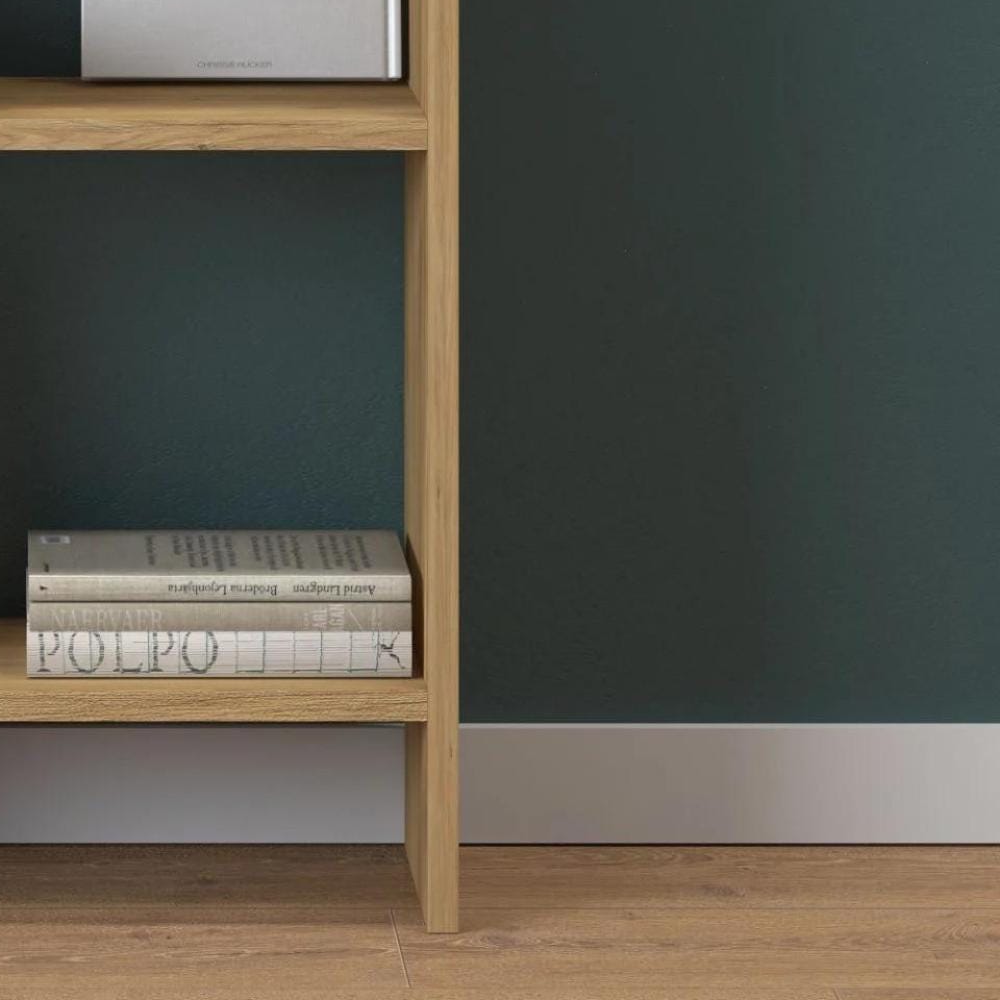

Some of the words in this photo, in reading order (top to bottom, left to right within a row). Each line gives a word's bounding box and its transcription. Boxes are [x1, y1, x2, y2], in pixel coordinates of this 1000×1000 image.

[293, 582, 341, 596] Lindgren
[343, 583, 376, 596] Astrid
[36, 631, 219, 673] POLPO
